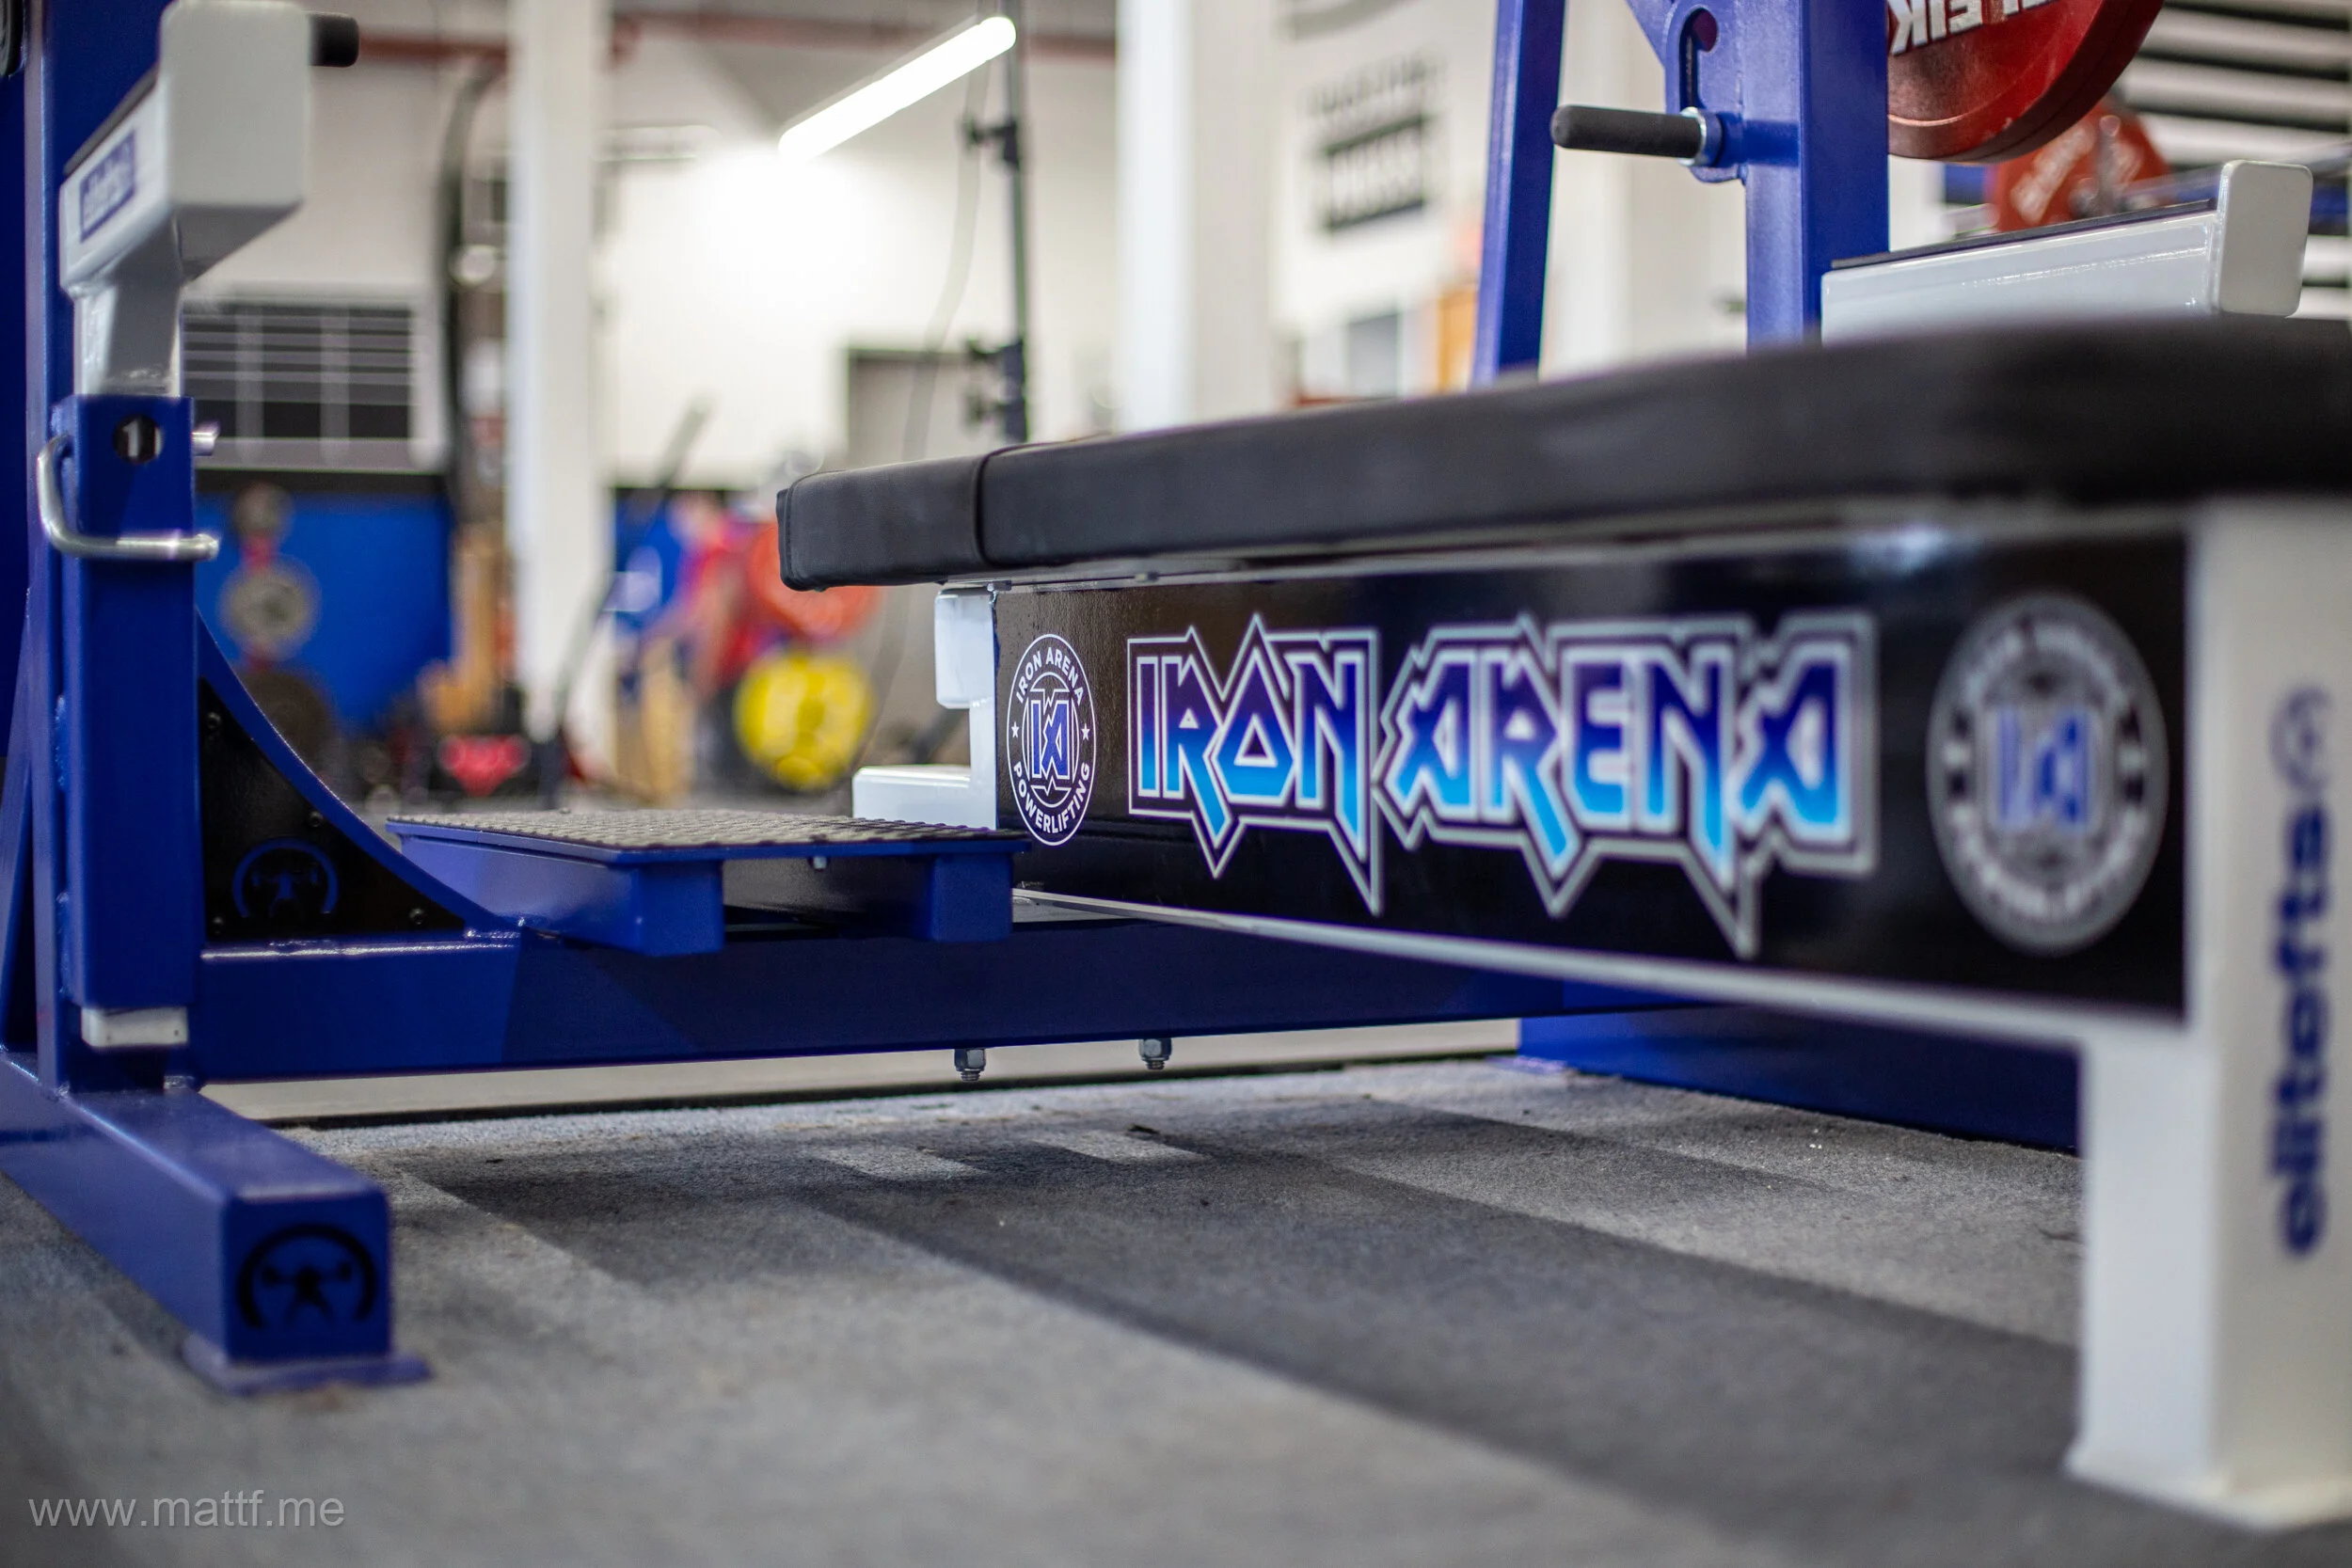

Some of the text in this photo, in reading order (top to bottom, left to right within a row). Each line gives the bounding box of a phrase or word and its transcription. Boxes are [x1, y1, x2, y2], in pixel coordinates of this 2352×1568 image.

[1016, 647, 1084, 705] IRON ARENA
[1013, 761, 1089, 833] POWERLIFTING
[1129, 616, 1876, 958] IRON ARENA
